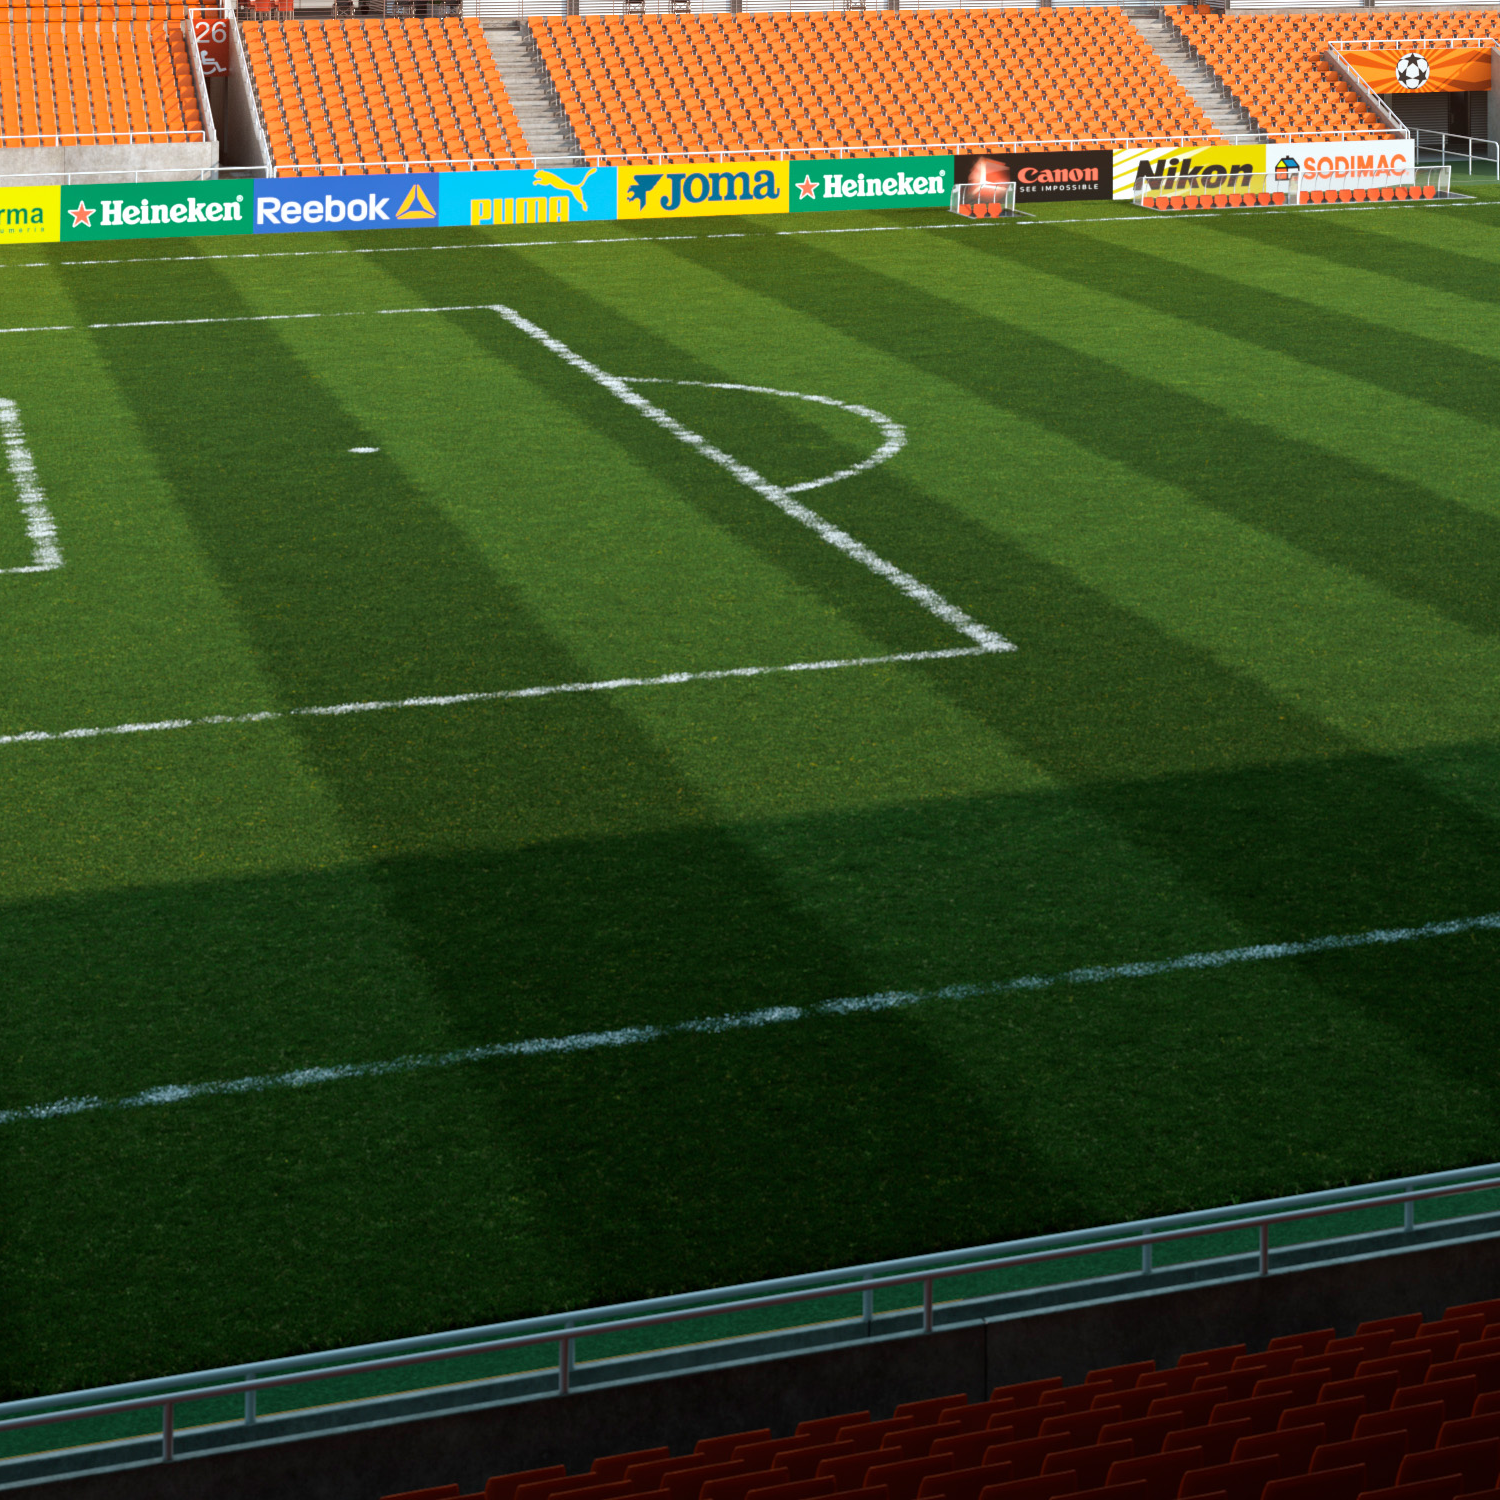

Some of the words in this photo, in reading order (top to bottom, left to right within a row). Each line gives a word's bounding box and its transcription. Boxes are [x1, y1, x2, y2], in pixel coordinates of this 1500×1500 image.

[195, 21, 227, 44] 26
[1017, 167, 1099, 184] Canon
[1133, 157, 1253, 190] Nikon
[1303, 153, 1407, 180] SODIMAC
[660, 169, 780, 211] Joma
[823, 172, 945, 198] Heineken
[1019, 185, 1037, 193] SEE
[1041, 183, 1099, 192] IMPOSSIBLE
[100, 197, 242, 226] Heineken
[257, 193, 390, 225] Reebok
[470, 196, 569, 225] PUMA
